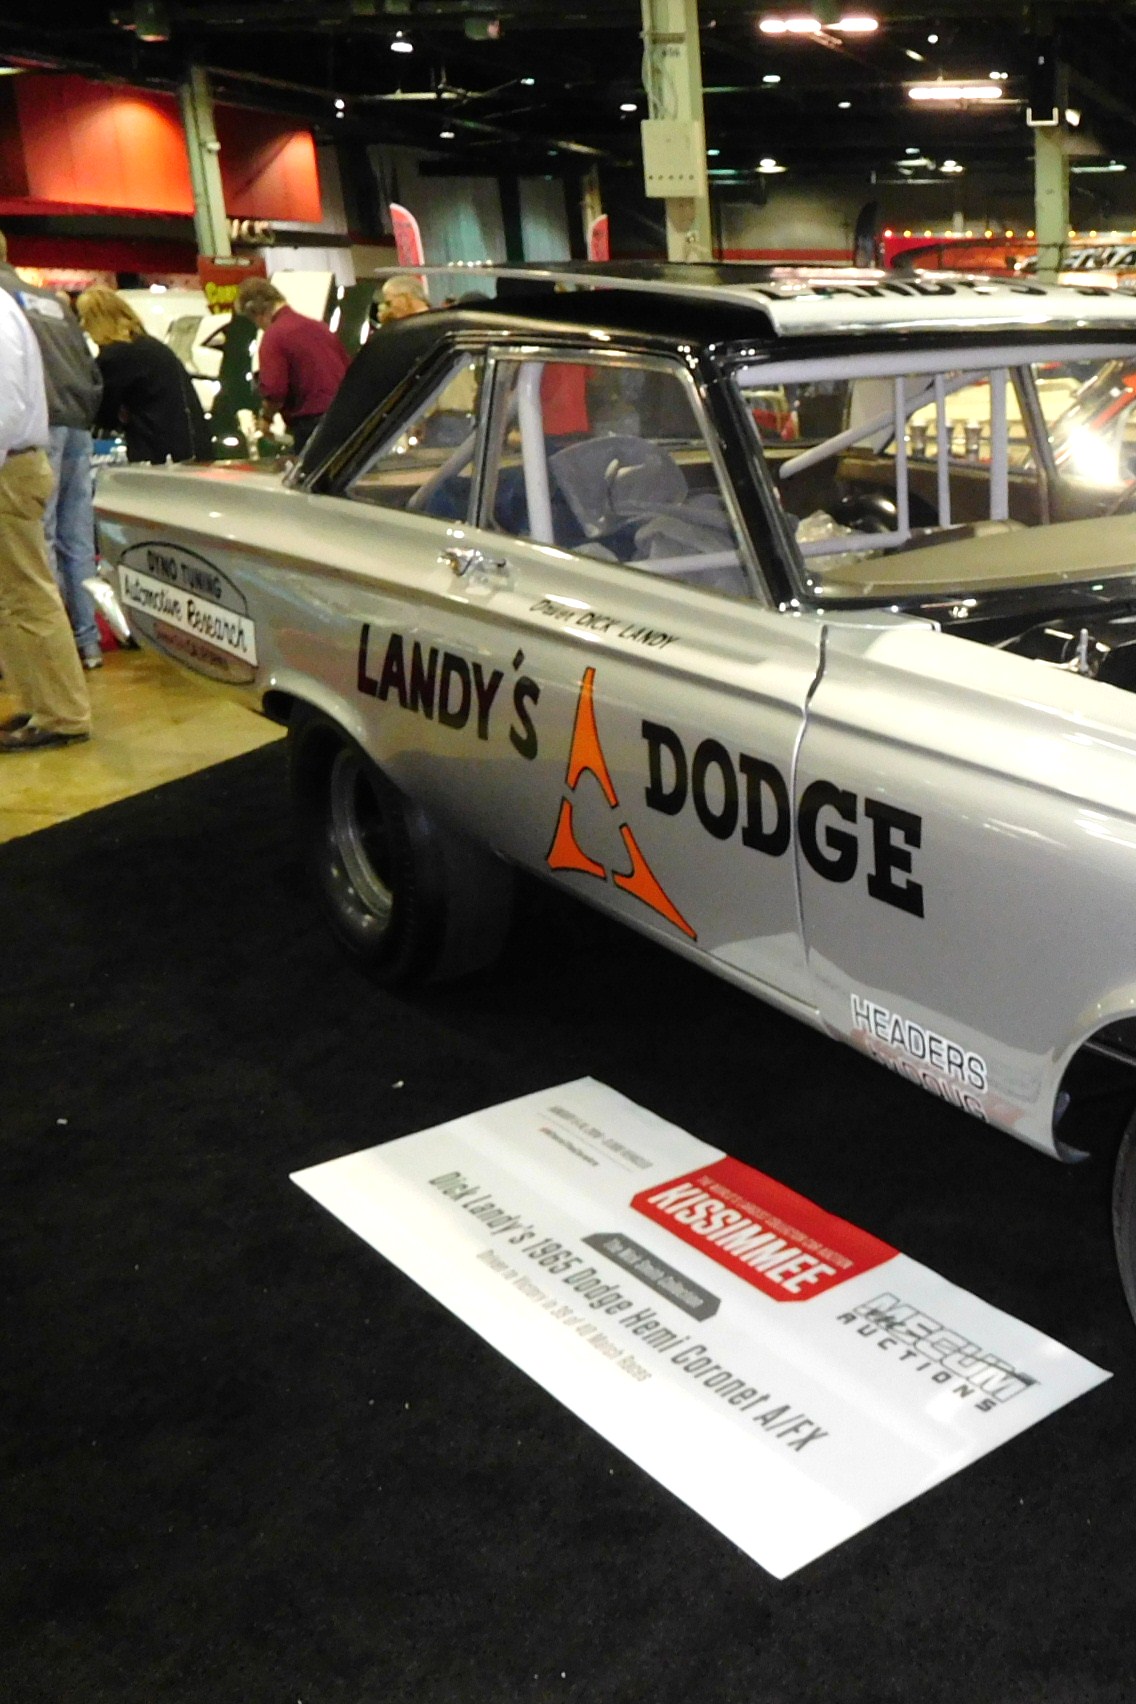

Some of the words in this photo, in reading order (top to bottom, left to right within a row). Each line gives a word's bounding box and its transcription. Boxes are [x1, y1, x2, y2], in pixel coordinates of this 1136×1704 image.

[147, 550, 178, 581] DYNO
[575, 612, 621, 633] DICK
[618, 624, 680, 649] LANDY
[356, 622, 541, 760] LANDY'S
[641, 718, 925, 919] DODGE
[851, 993, 988, 1094] HEADERS
[647, 1181, 837, 1294] KISSIMMEE
[429, 1171, 481, 1201] Dick
[461, 1194, 536, 1245] Landy's
[521, 1237, 584, 1274] 1965
[562, 1267, 634, 1316] Dodge
[618, 1307, 691, 1353] Hemi
[670, 1344, 771, 1412] Coronet
[752, 1404, 829, 1452] A/FX
[836, 1312, 998, 1412] AUCTIONS
[853, 1291, 1041, 1403] MECUM
